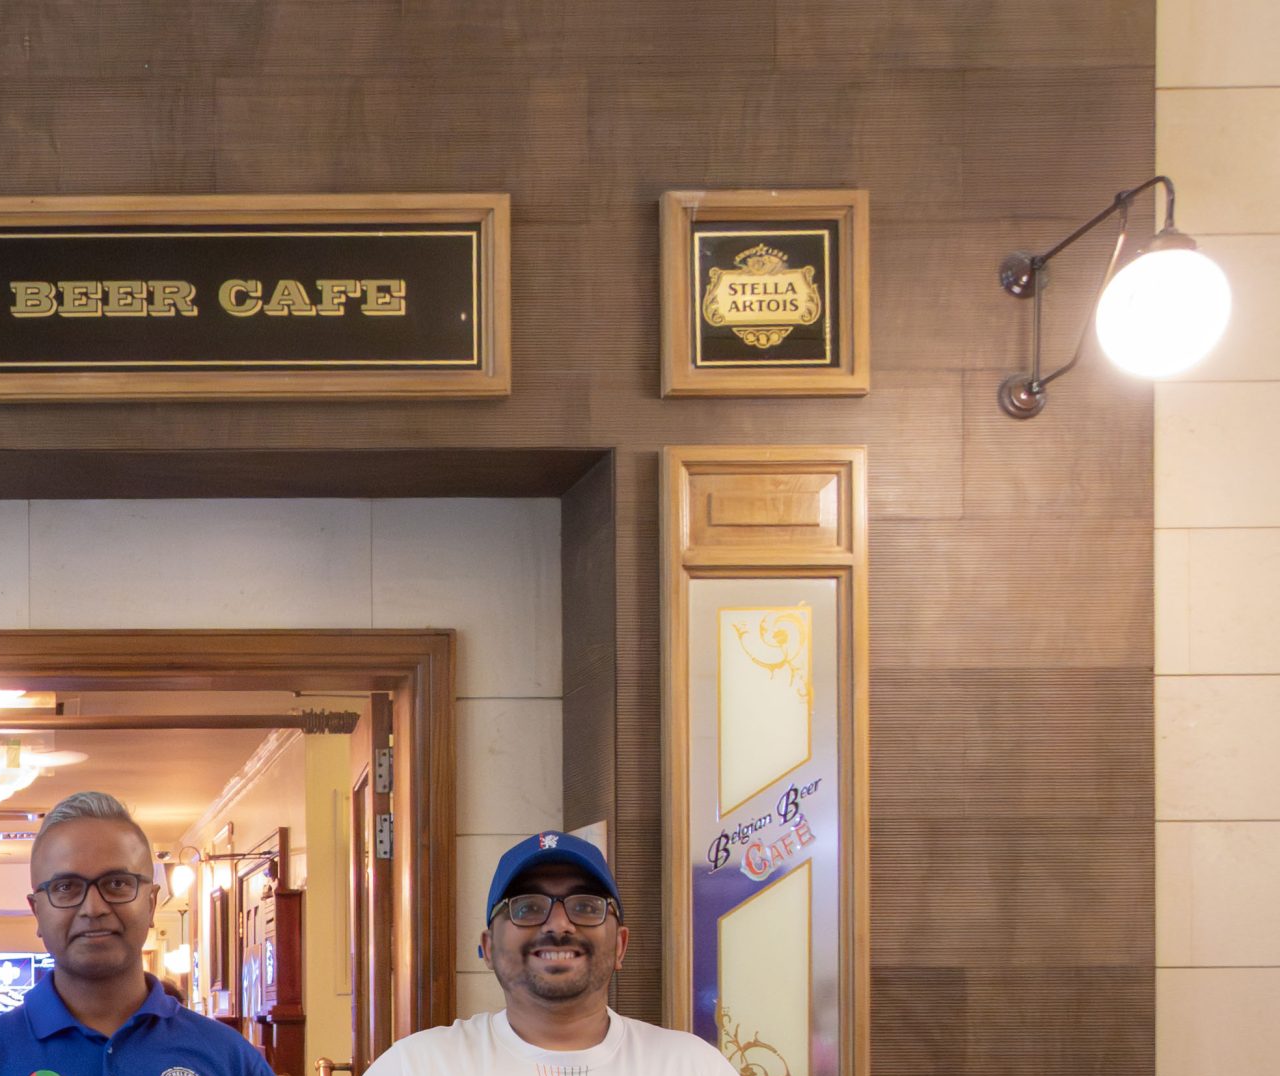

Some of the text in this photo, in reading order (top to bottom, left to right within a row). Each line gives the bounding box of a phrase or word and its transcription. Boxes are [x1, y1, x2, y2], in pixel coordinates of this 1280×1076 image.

[9, 279, 199, 318] BEER
[217, 278, 407, 317] CAFE
[728, 281, 798, 296] STELLA
[728, 299, 799, 313] ARTOIS
[706, 777, 823, 875] Belgian Beer
